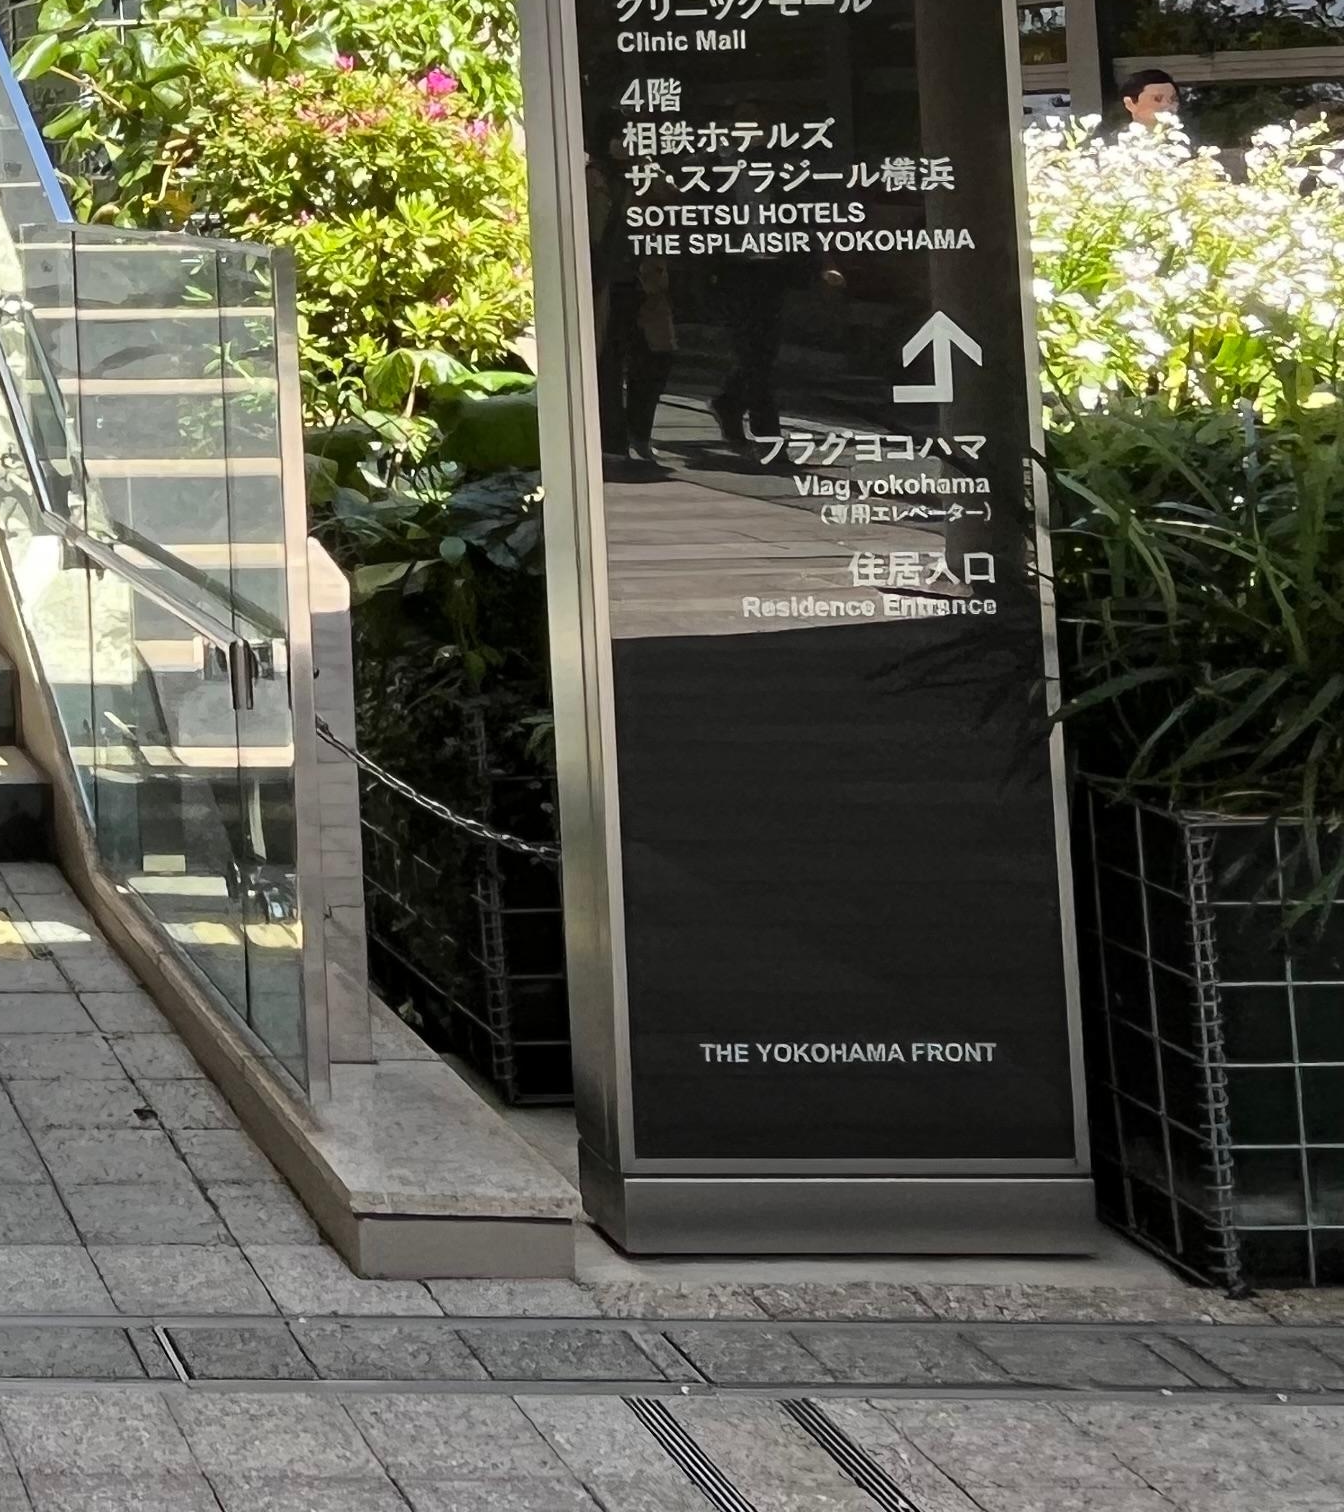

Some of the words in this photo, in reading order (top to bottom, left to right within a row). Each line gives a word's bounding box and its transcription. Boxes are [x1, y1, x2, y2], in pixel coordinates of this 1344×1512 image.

[617, 31, 688, 52] Clinic
[696, 29, 747, 51] Mall
[619, 77, 682, 113] 4階
[622, 117, 835, 156] 相鉄ホテルズ
[625, 157, 956, 194] ザ・スプラジール横浜
[626, 205, 750, 227] SOTETSU
[759, 202, 866, 225] HOTELS
[628, 234, 681, 255] THE
[689, 231, 811, 255] SPLAISIR
[816, 228, 976, 252] YOKOHAMA
[793, 474, 851, 501] Vlag
[855, 473, 992, 500] yokohama
[847, 551, 996, 587] 住居入口
[742, 595, 876, 618] Residence
[882, 592, 998, 617] Entrance
[699, 1043, 749, 1063] THE
[756, 1042, 906, 1063] YOKOHAMA
[912, 1041, 997, 1063] FRONT
